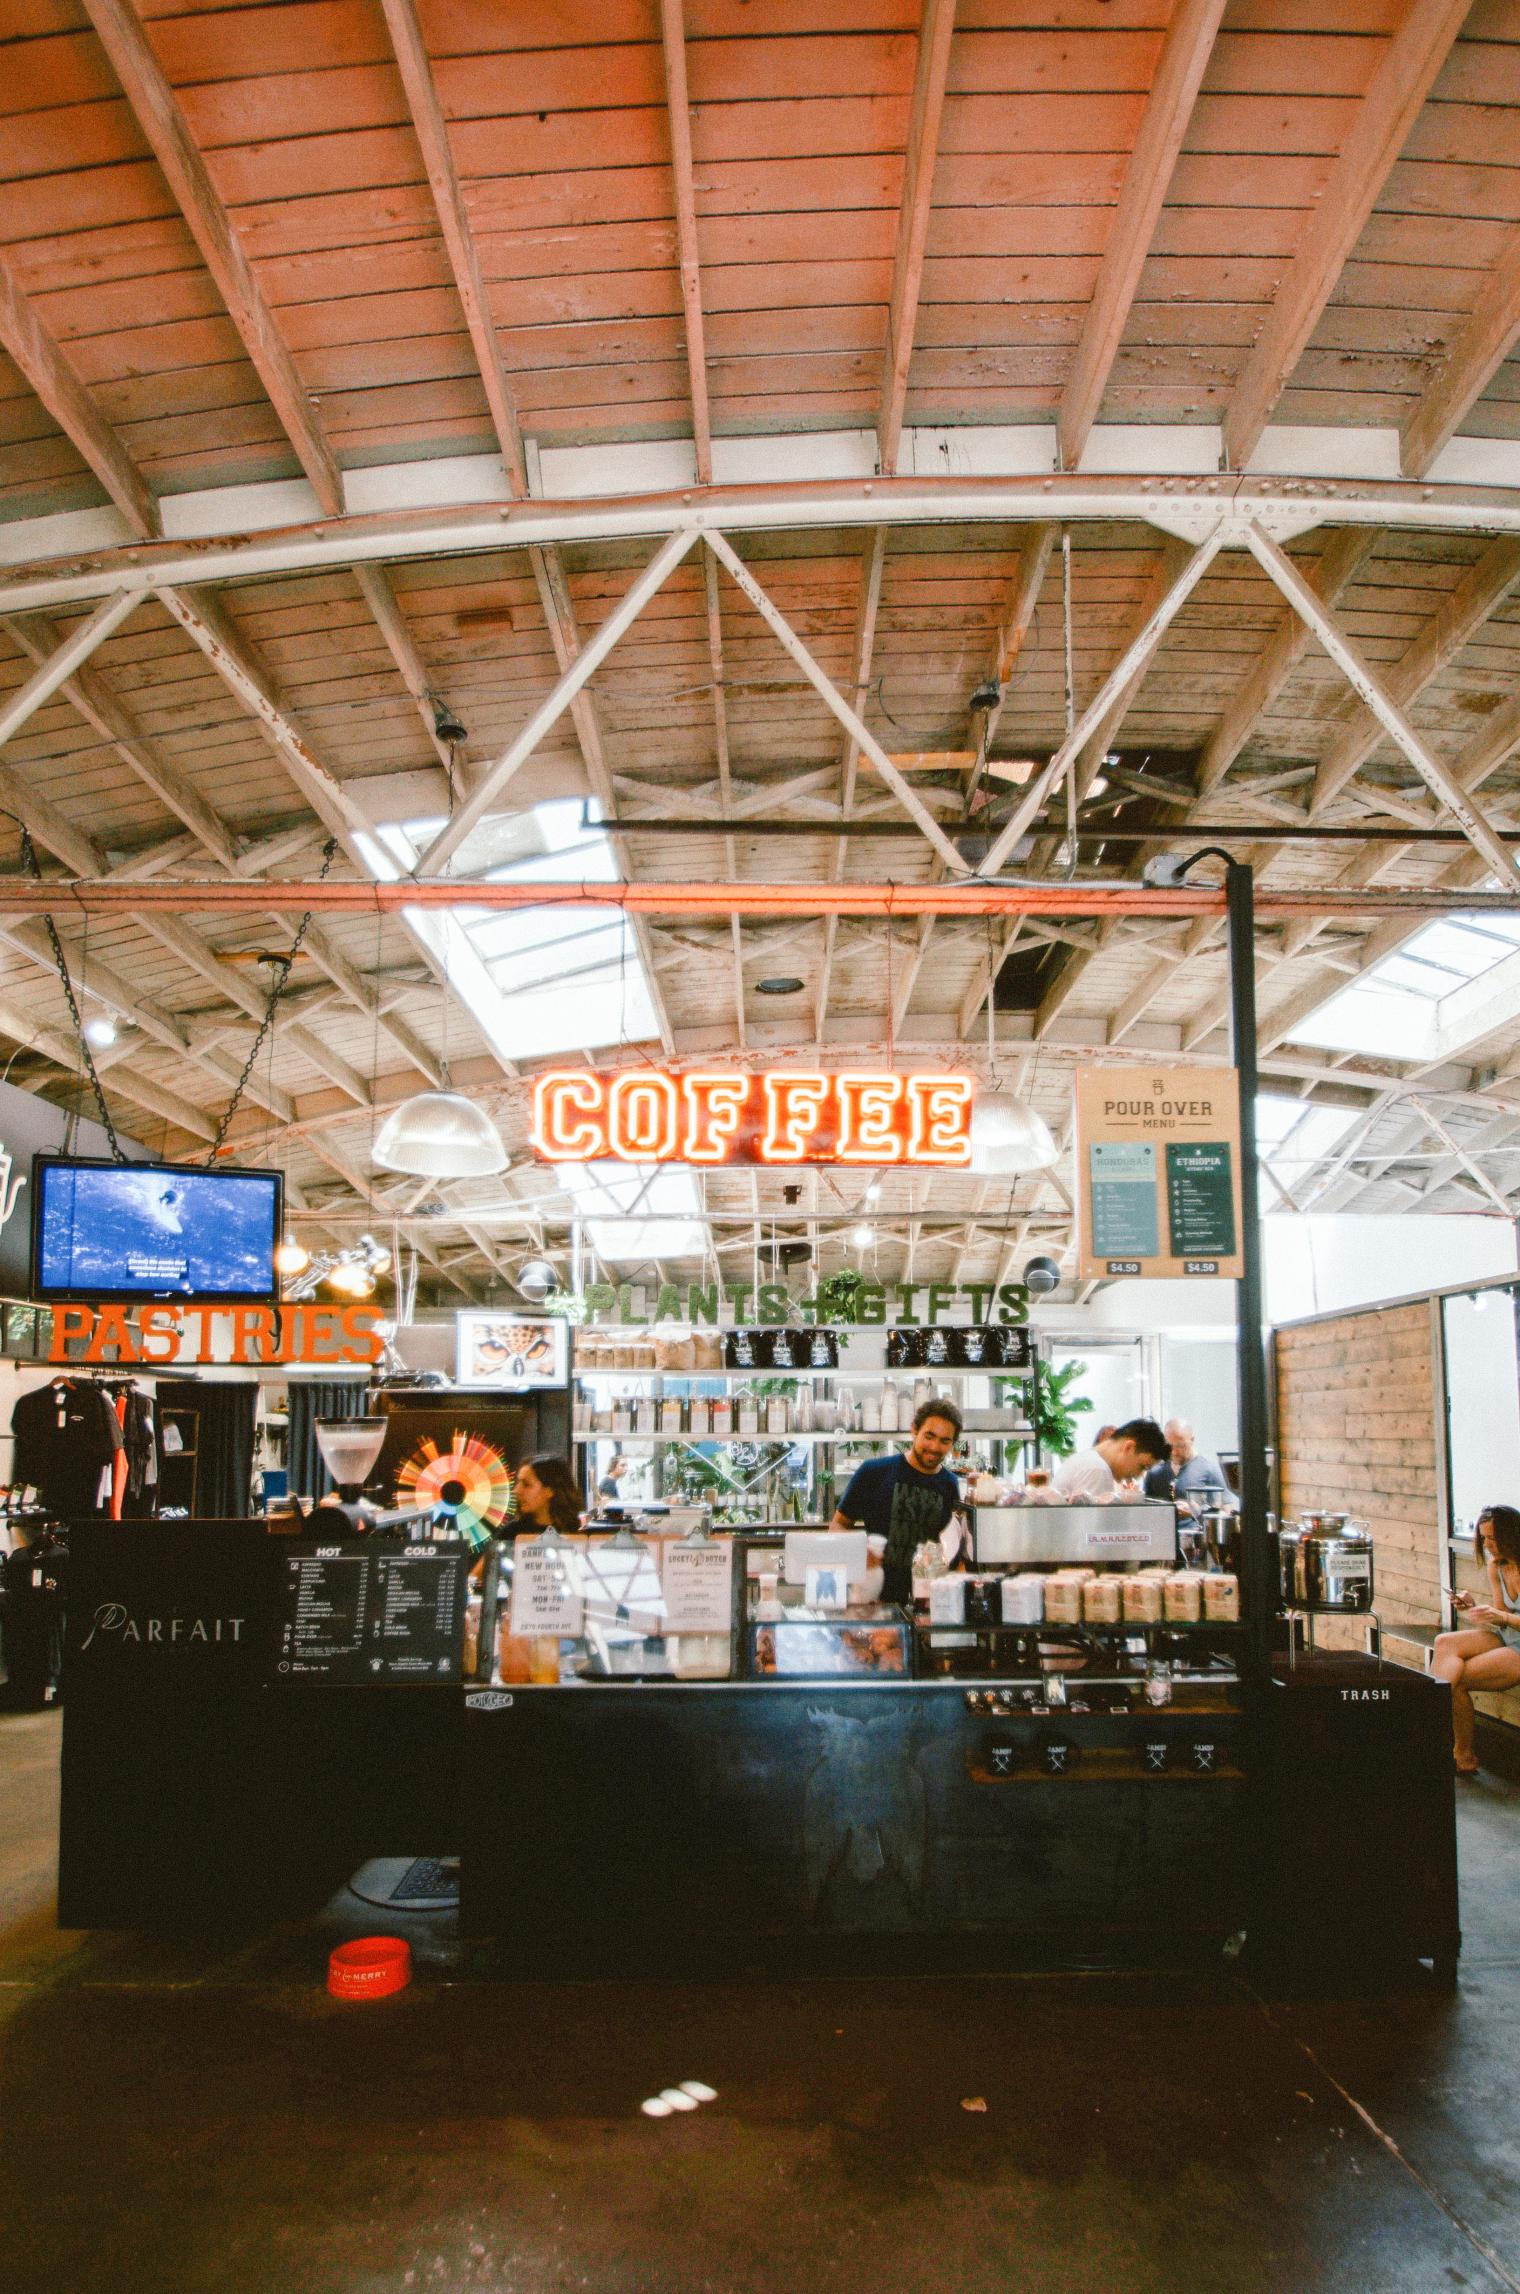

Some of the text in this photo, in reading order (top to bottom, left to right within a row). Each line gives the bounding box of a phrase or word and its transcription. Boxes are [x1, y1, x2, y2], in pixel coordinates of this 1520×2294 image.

[1104, 1101, 1213, 1115] POUR OVER
[533, 1073, 973, 1161] COFFEE
[1142, 1119, 1176, 1128] MENU
[1176, 1157, 1221, 1166] ETHIOPIA
[1110, 1263, 1215, 1272] $4.50 $4.50
[584, 1283, 789, 1326] PLANTS
[855, 1284, 1029, 1326] GIFTS
[48, 1304, 385, 1363] PASTRIES
[316, 1547, 342, 1557] HOT
[404, 1546, 437, 1556] COLD
[525, 1561, 542, 1570] NEW
[81, 1602, 245, 1650] PARFAIT
[537, 1623, 560, 1631] FOURTH
[1340, 1690, 1390, 1700] TRASH
[353, 1970, 387, 1980] MERRY
